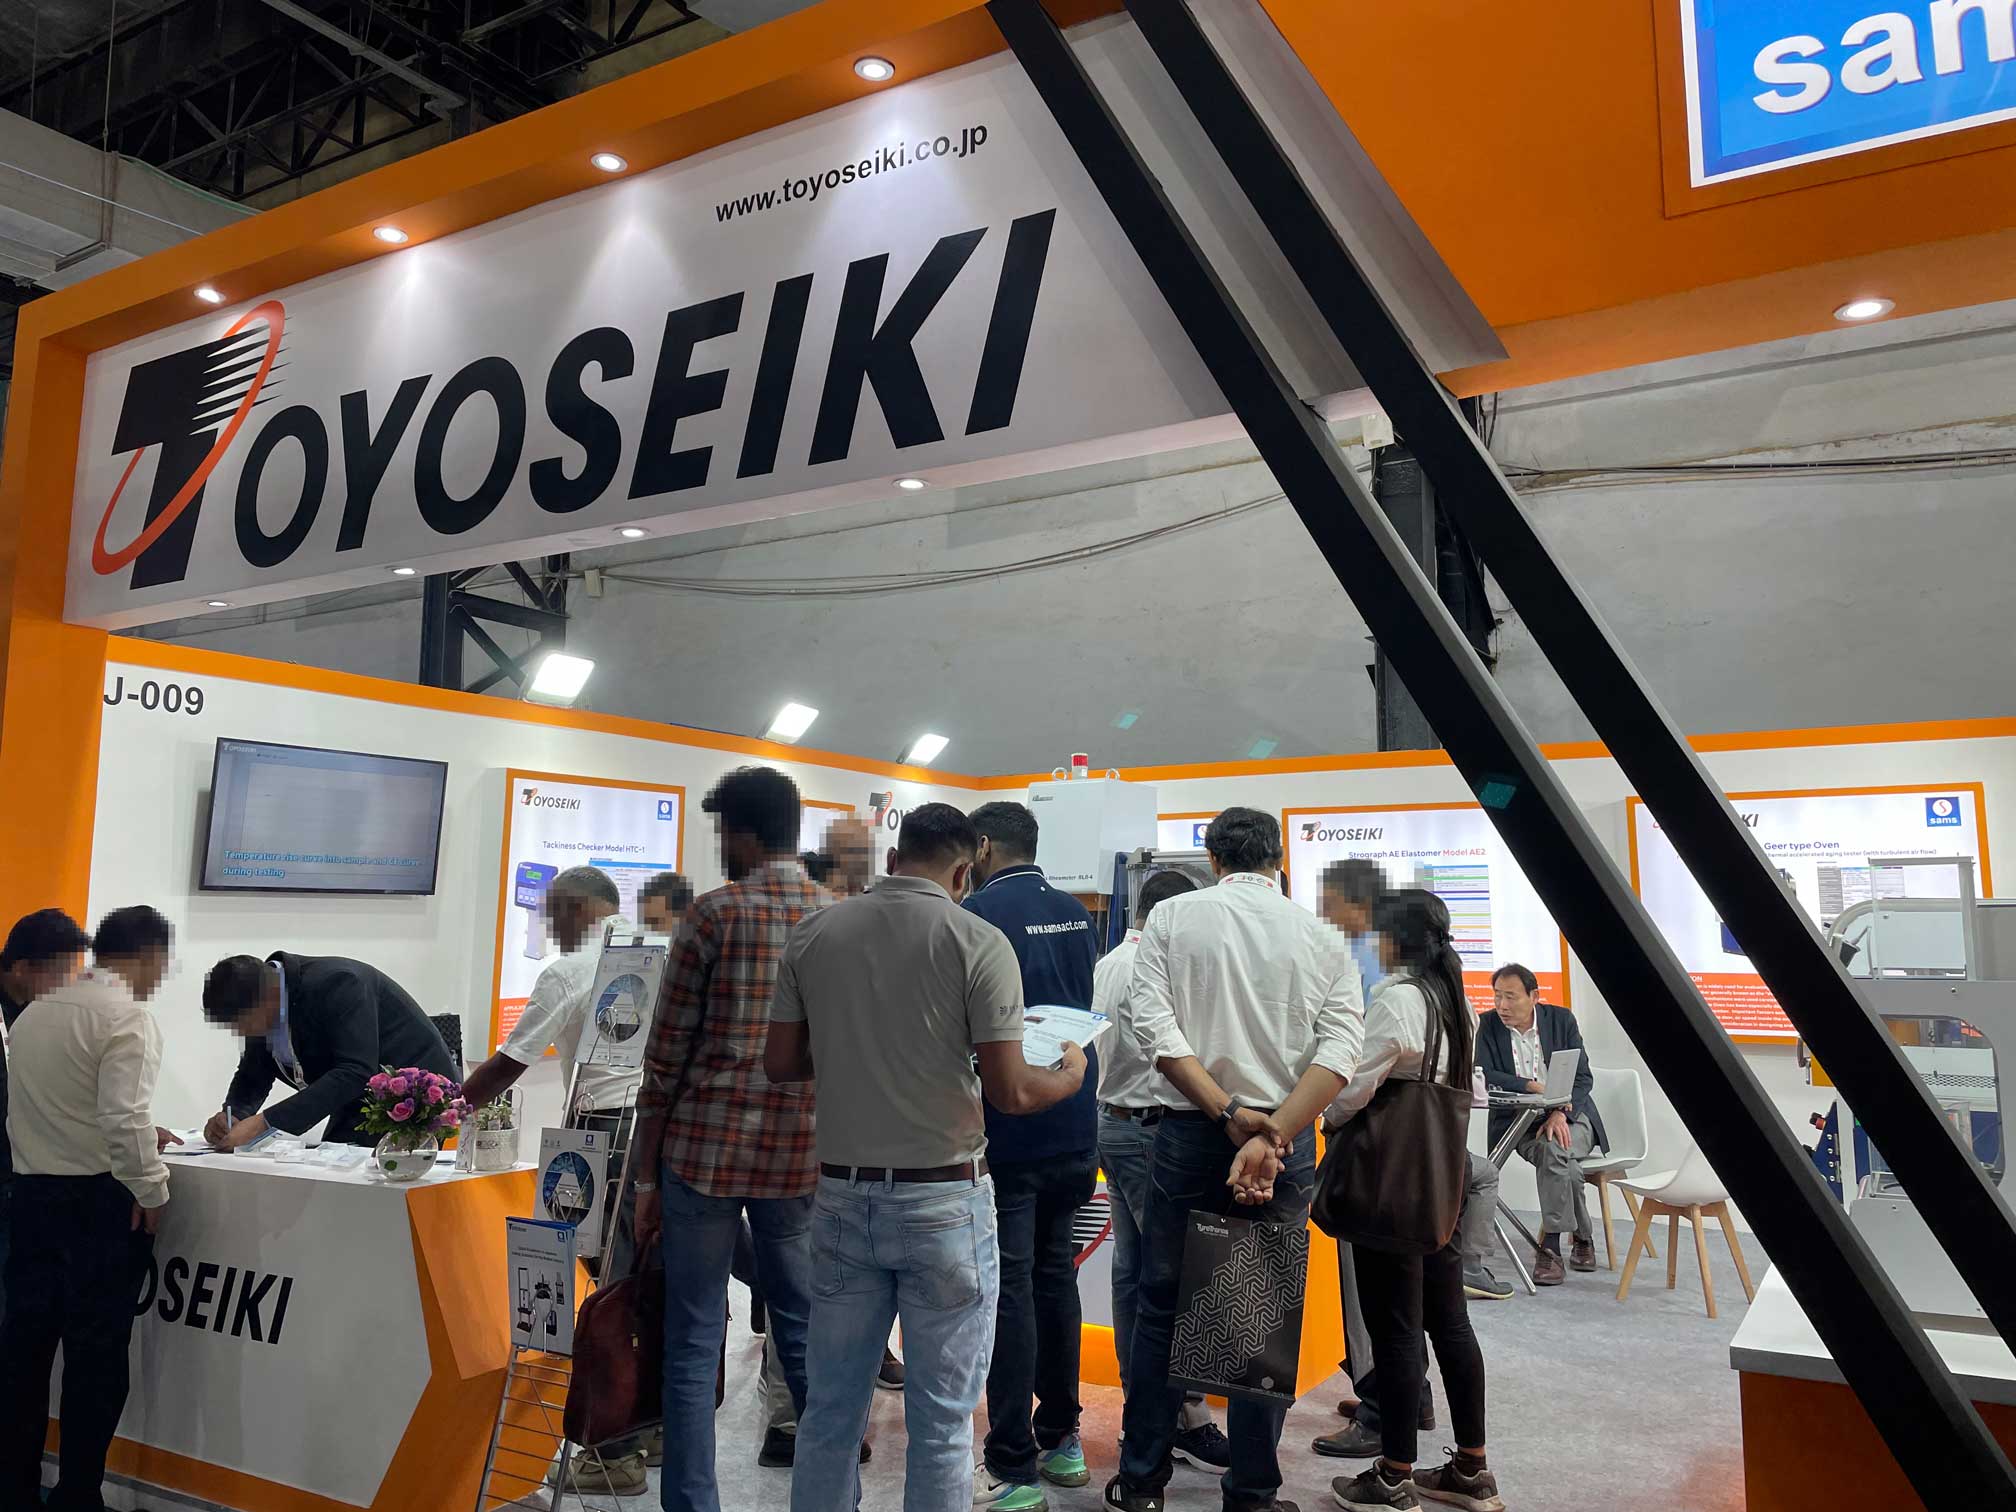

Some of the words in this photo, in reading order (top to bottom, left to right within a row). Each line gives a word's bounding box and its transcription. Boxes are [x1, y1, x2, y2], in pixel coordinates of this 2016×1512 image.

[716, 125, 988, 222] www.toyoseiki.co.jp
[100, 208, 1056, 590] TOYOSEIKI
[104, 677, 204, 716] J-009
[523, 788, 581, 810] TOYOSEIKI
[1930, 817, 1958, 825] sams
[1301, 821, 1383, 842] TOYOSEIKI
[543, 841, 576, 850] Tackiness
[577, 843, 605, 851] Checker
[605, 844, 625, 852] Model
[625, 845, 645, 853] HTC-1
[1349, 851, 1388, 859] Strograph
[1401, 849, 1441, 857] Elastomer
[1442, 848, 1468, 856] Model
[1469, 848, 1487, 856] AE2
[1764, 842, 1787, 850] Geer
[1789, 843, 1811, 851] type
[1813, 841, 1840, 849] Oven
[223, 867, 251, 877] during
[254, 868, 285, 879] testing
[1025, 920, 1088, 936] www.samsact.com
